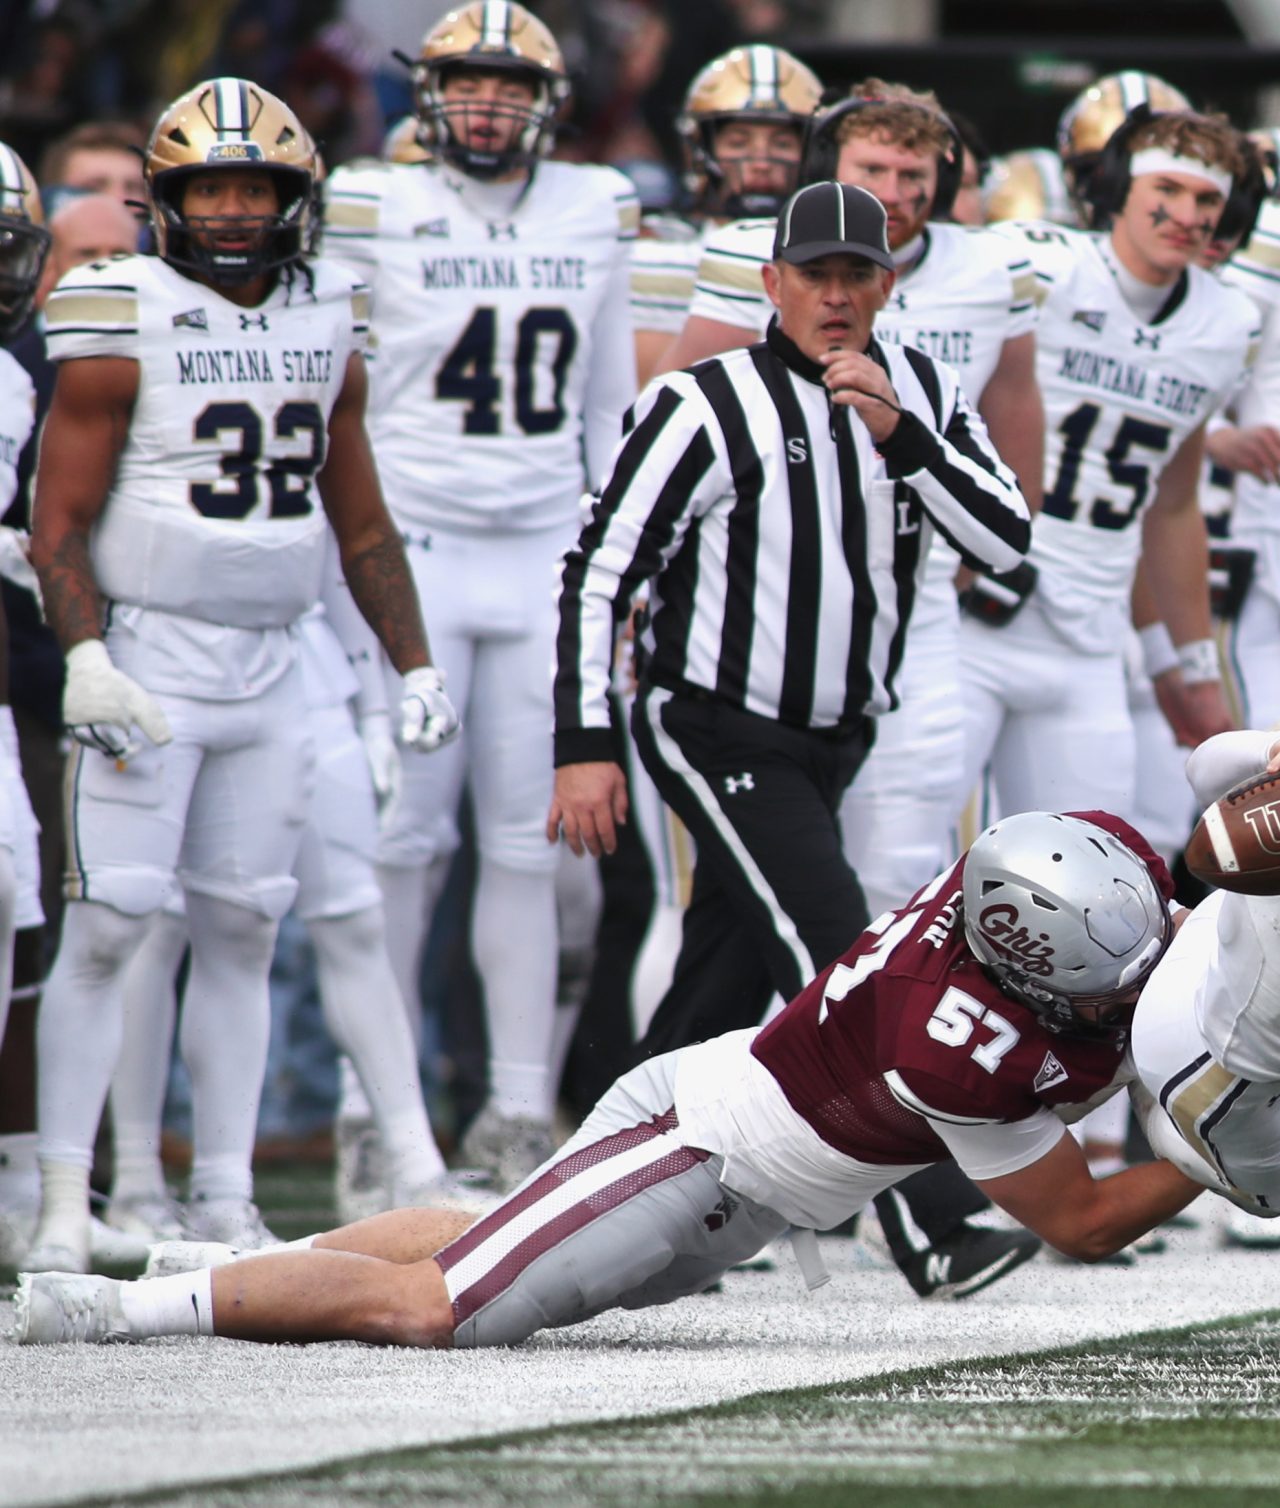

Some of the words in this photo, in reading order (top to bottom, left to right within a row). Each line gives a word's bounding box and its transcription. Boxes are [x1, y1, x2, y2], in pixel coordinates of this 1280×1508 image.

[219, 144, 248, 158] 406
[421, 257, 520, 291] MONTANA
[531, 257, 587, 291] STATE
[177, 348, 275, 384] MONTANA
[433, 304, 580, 437] 40
[1057, 347, 1148, 401] MONTANA
[188, 400, 327, 521] 32
[786, 438, 808, 464] S
[1039, 401, 1173, 531] 15
[896, 502, 919, 535] L
[979, 903, 1056, 977] Griz
[925, 984, 1022, 1075] 57
[926, 1253, 952, 1283] N
